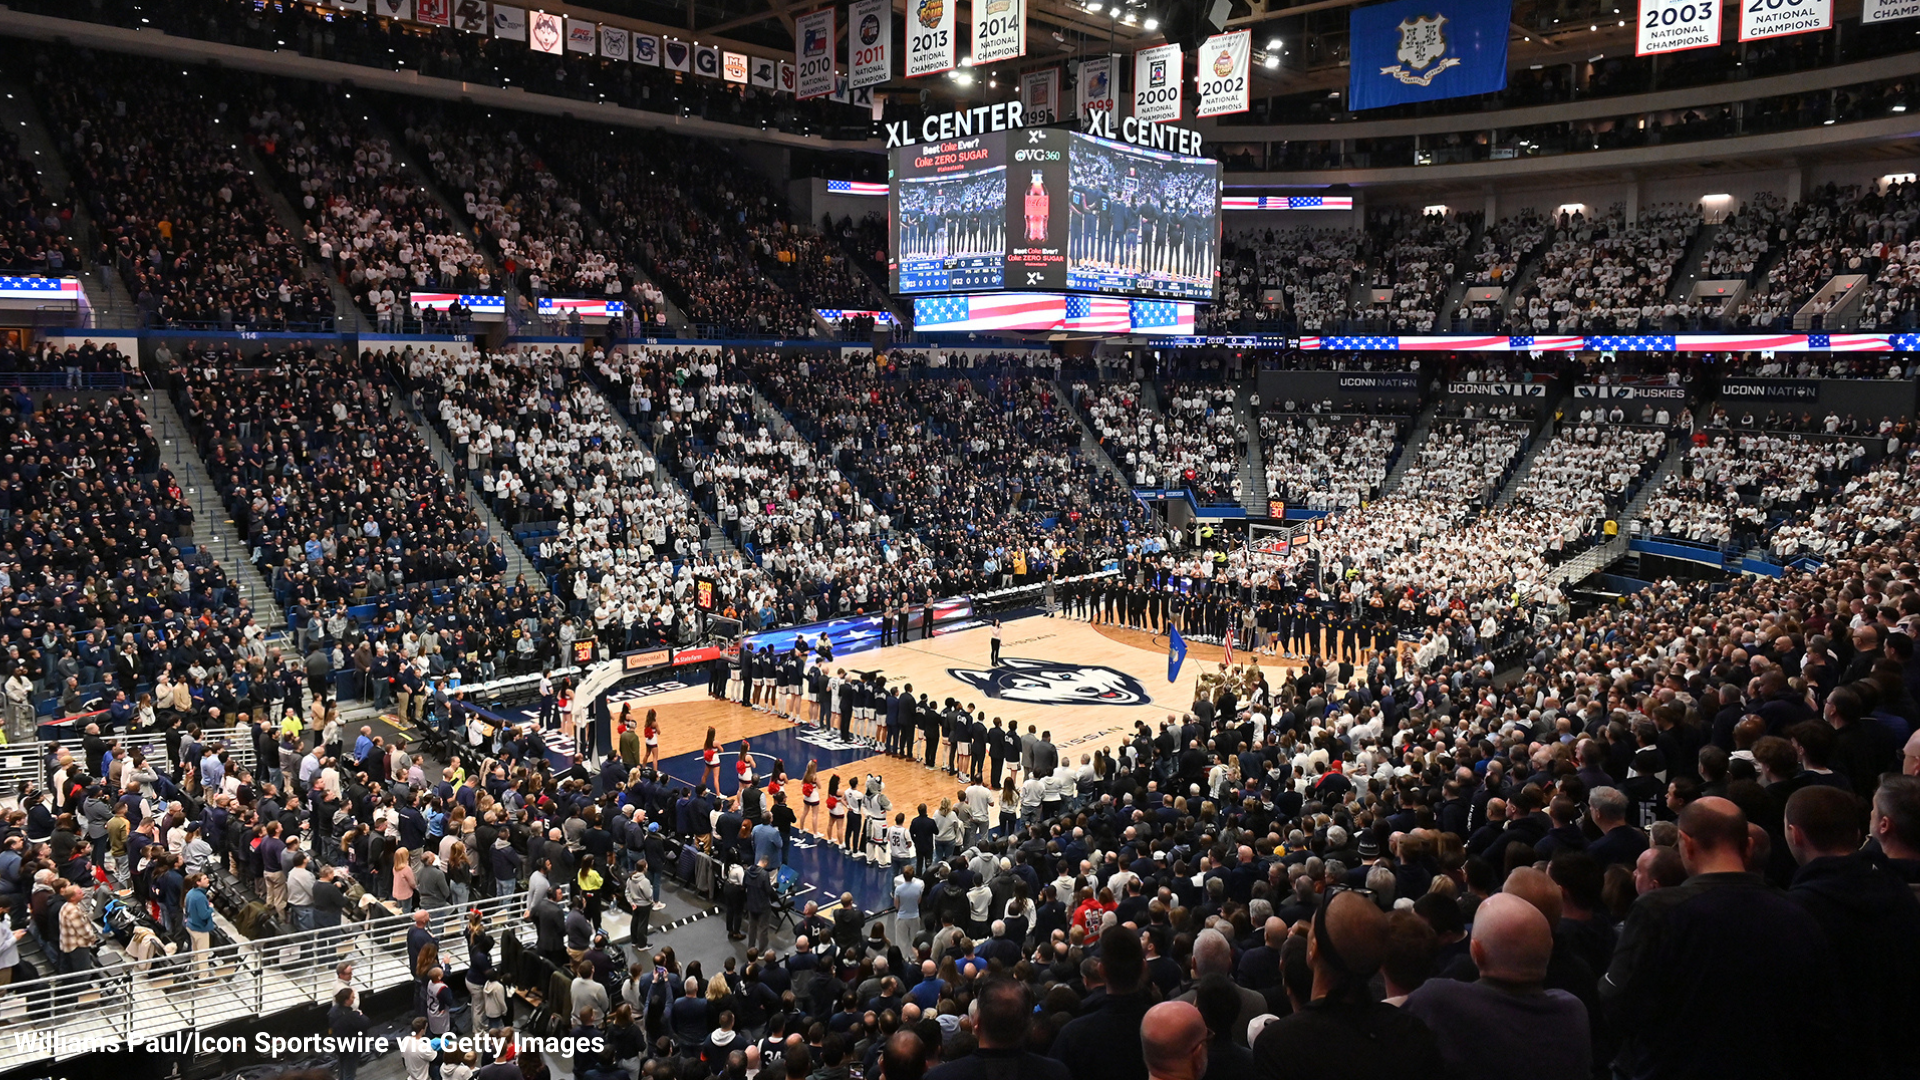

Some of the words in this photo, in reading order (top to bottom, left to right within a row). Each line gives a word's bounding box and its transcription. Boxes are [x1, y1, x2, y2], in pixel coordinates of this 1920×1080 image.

[1645, 2, 1712, 29] 2003
[1756, 8, 1815, 24] NATIONAL
[573, 28, 590, 36] BIG
[978, 14, 1018, 39] 2014
[1651, 25, 1705, 39] NATIONAL
[1750, 18, 1820, 37] CHAMPIONS
[570, 33, 594, 42] EAST
[912, 29, 948, 53] 2013
[981, 36, 1016, 49] NATIONAL
[1646, 35, 1709, 51] CHAMPIONS
[855, 45, 884, 67] 2011
[913, 50, 945, 63] NATIONAL
[978, 46, 1019, 60] CHAMPIONS
[800, 57, 830, 78] 2010
[855, 65, 884, 76] NATIONAL
[911, 60, 948, 74] CHAMPIONS
[802, 76, 829, 87] NATIONAL
[853, 73, 887, 86] CHAMPIONS
[800, 84, 831, 96] CHAMPIONS
[1202, 78, 1244, 97] 2002
[1137, 87, 1177, 106] 2000
[1206, 94, 1239, 105] NATIONAL
[1141, 104, 1173, 114] NATIONAL
[1203, 104, 1242, 115] CHAMPIONS
[886, 120, 915, 148] XL
[922, 100, 1024, 142] CENTER
[1028, 130, 1046, 144] XL
[1088, 108, 1117, 140] XL
[1122, 116, 1202, 156] CENTER
[923, 144, 940, 155] Best
[940, 142, 957, 153] Coke
[957, 138, 980, 150] Ever?
[914, 156, 934, 168] Coke
[934, 153, 957, 166] ZERO
[958, 149, 988, 162] SUGAR
[868, 211, 880, 219] 219
[1026, 272, 1044, 285] XL
[1340, 377, 1376, 387] UCONN
[1448, 383, 1491, 394] UCONN
[1633, 388, 1685, 398] HUSKIES
[1722, 385, 1765, 396] UCONN
[1270, 500, 1284, 509] 20:00
[1271, 507, 1284, 519] 30
[697, 580, 712, 592] 20:00
[698, 591, 711, 608] 30
[574, 640, 592, 651] 20:00
[578, 649, 590, 661] 30
[1638, 801, 1657, 828] 15
[891, 835, 900, 847] 32
